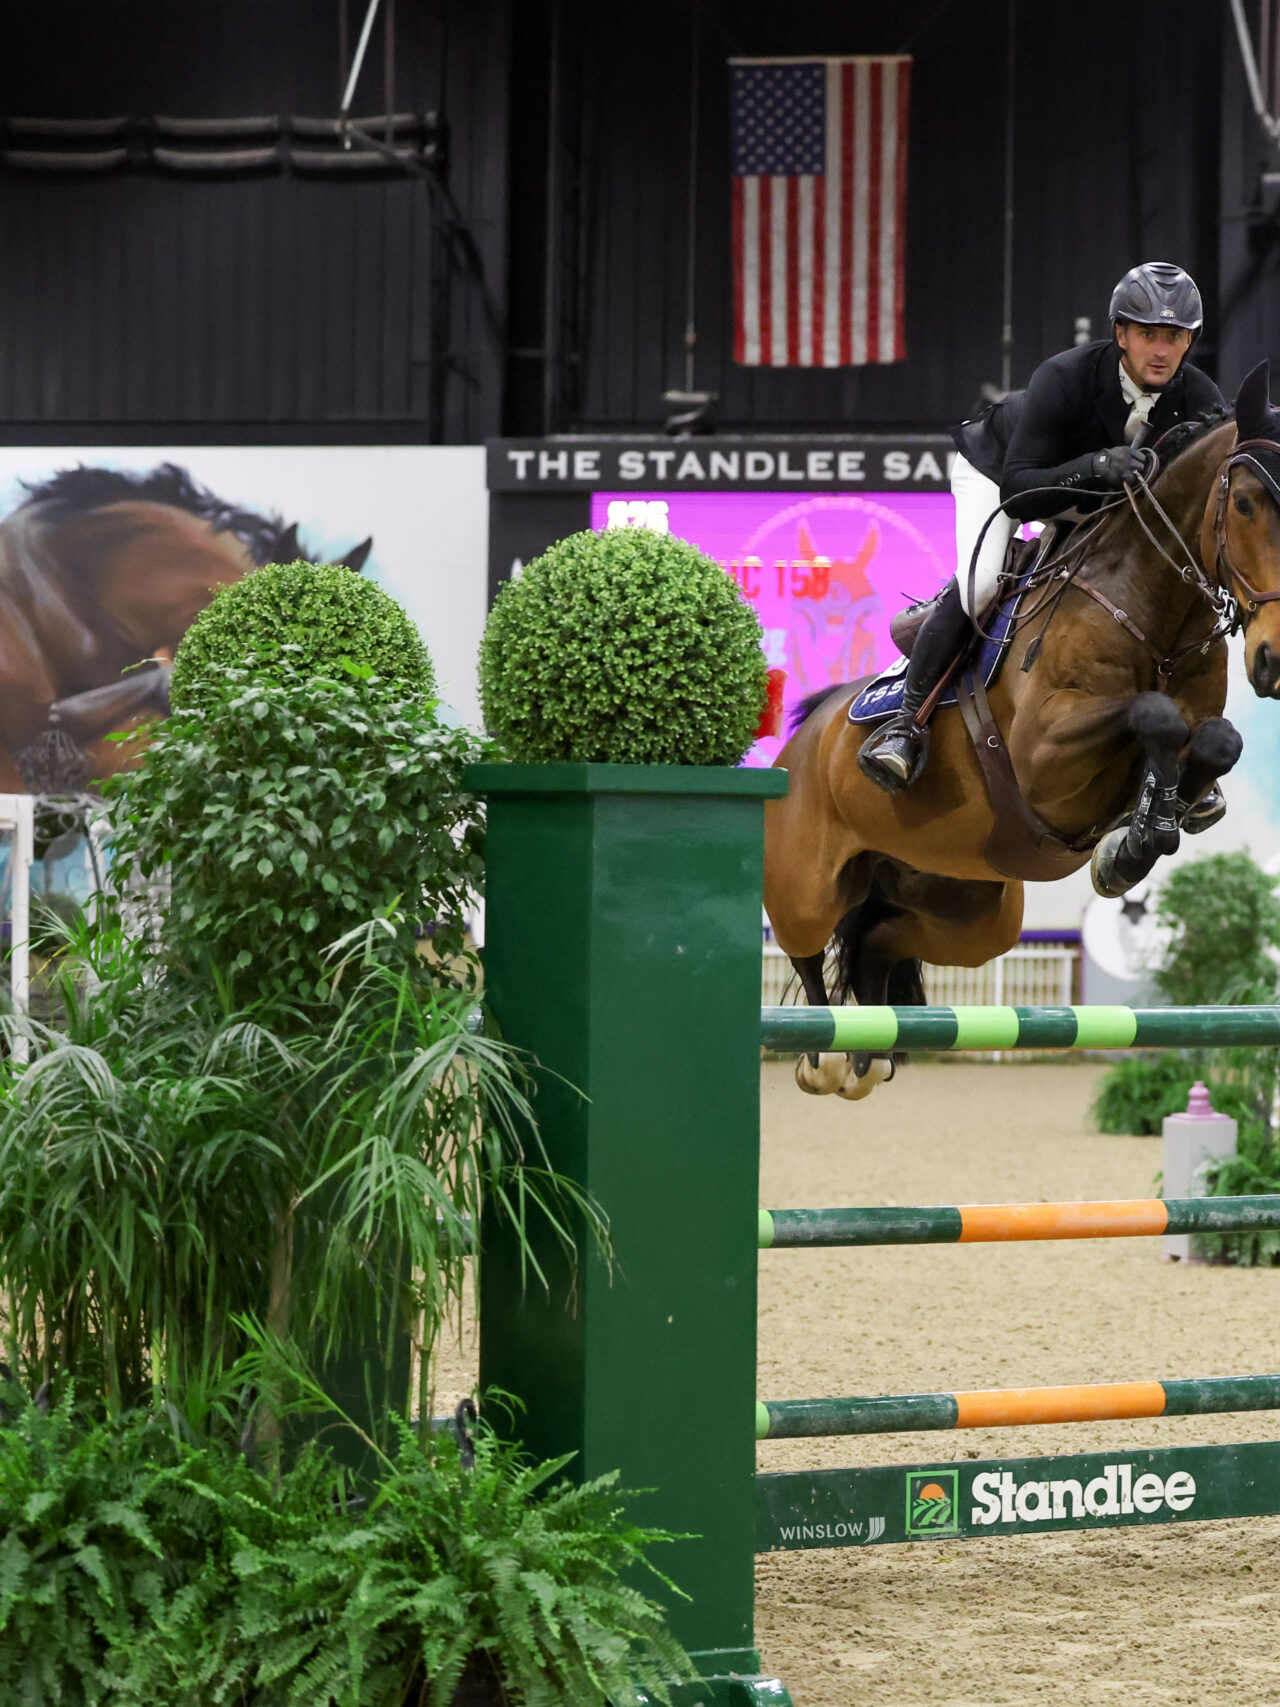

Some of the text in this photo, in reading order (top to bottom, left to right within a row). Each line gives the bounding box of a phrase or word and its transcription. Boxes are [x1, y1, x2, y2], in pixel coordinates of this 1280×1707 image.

[507, 451, 601, 480] THE
[619, 451, 865, 480] STANDLEE
[971, 1463, 1196, 1525] Standlee
[780, 1522, 863, 1541] WINSLOW
